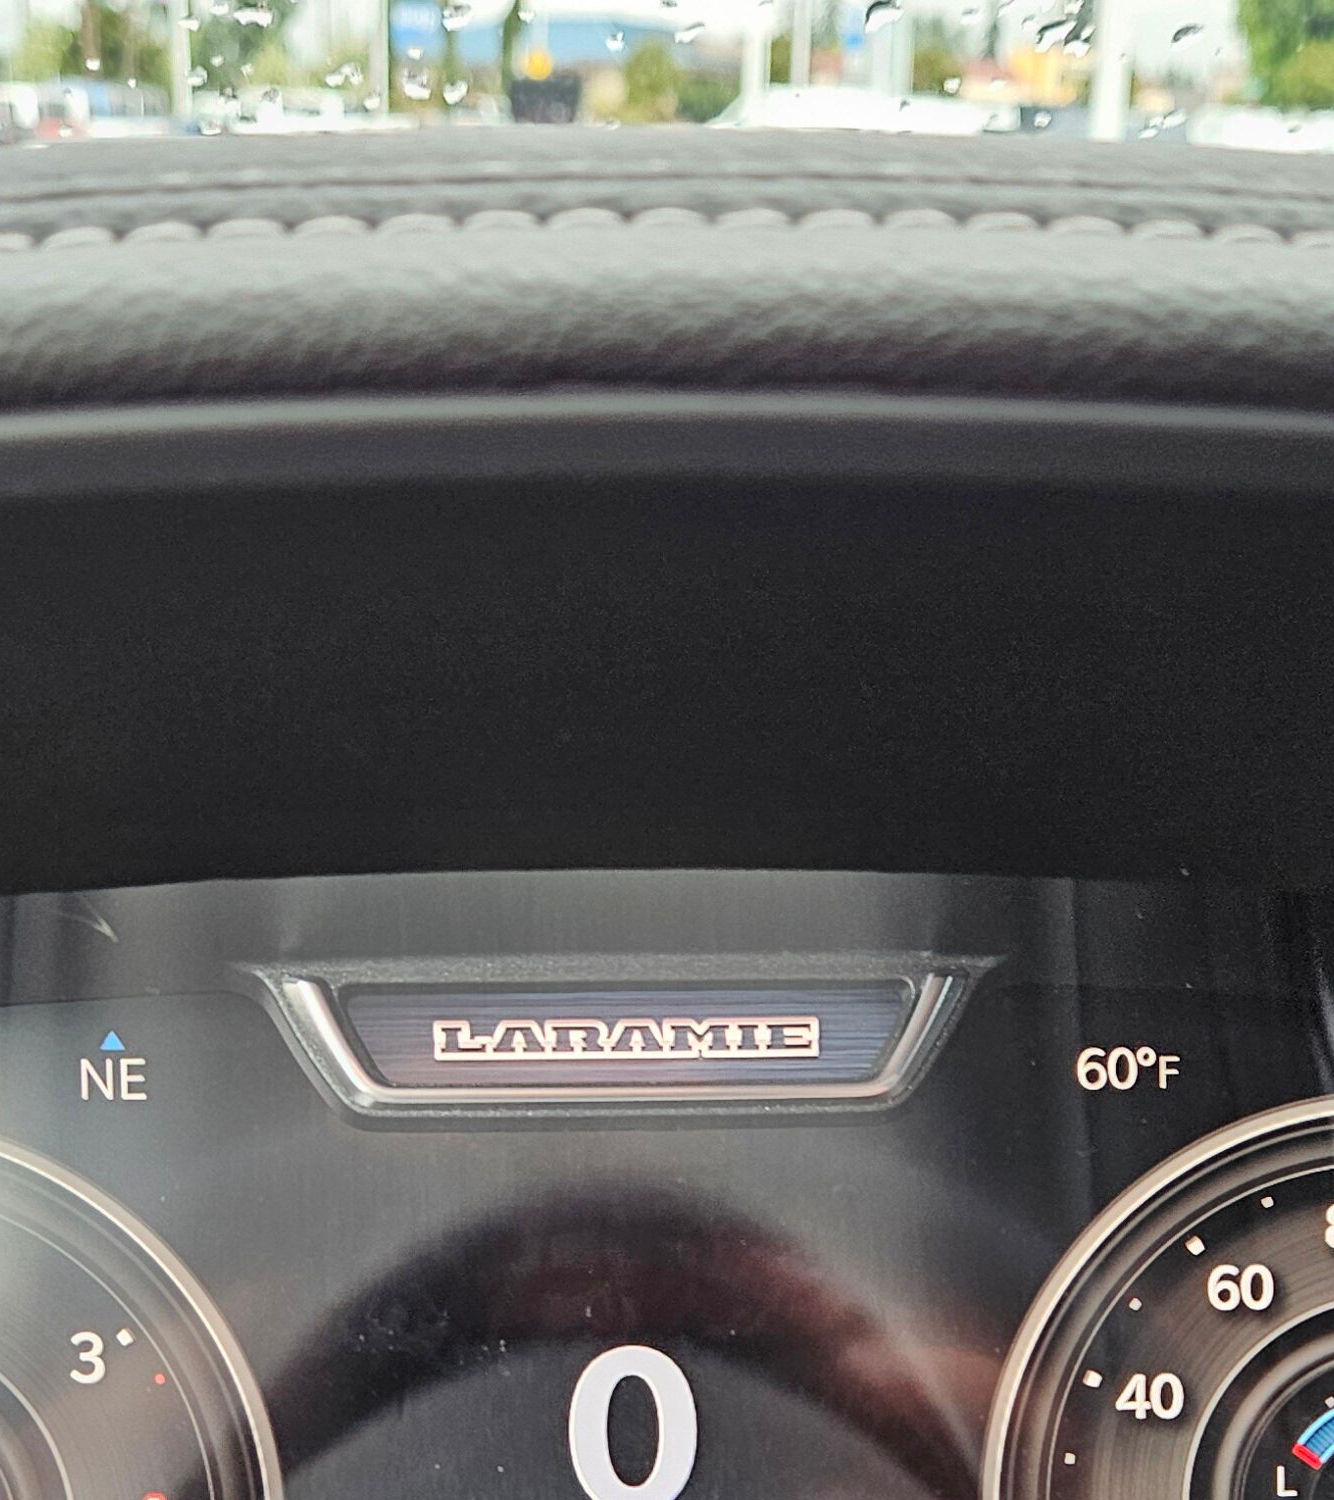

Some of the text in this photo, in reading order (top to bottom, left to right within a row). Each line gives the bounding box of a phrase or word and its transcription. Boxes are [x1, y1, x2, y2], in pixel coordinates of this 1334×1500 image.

[433, 1016, 820, 1061] LARAMIE
[79, 1058, 148, 1102] NE
[1206, 1264, 1275, 1311] 60
[69, 1331, 107, 1384] 3
[1115, 1372, 1185, 1420] 40
[1276, 1467, 1297, 1498] L
